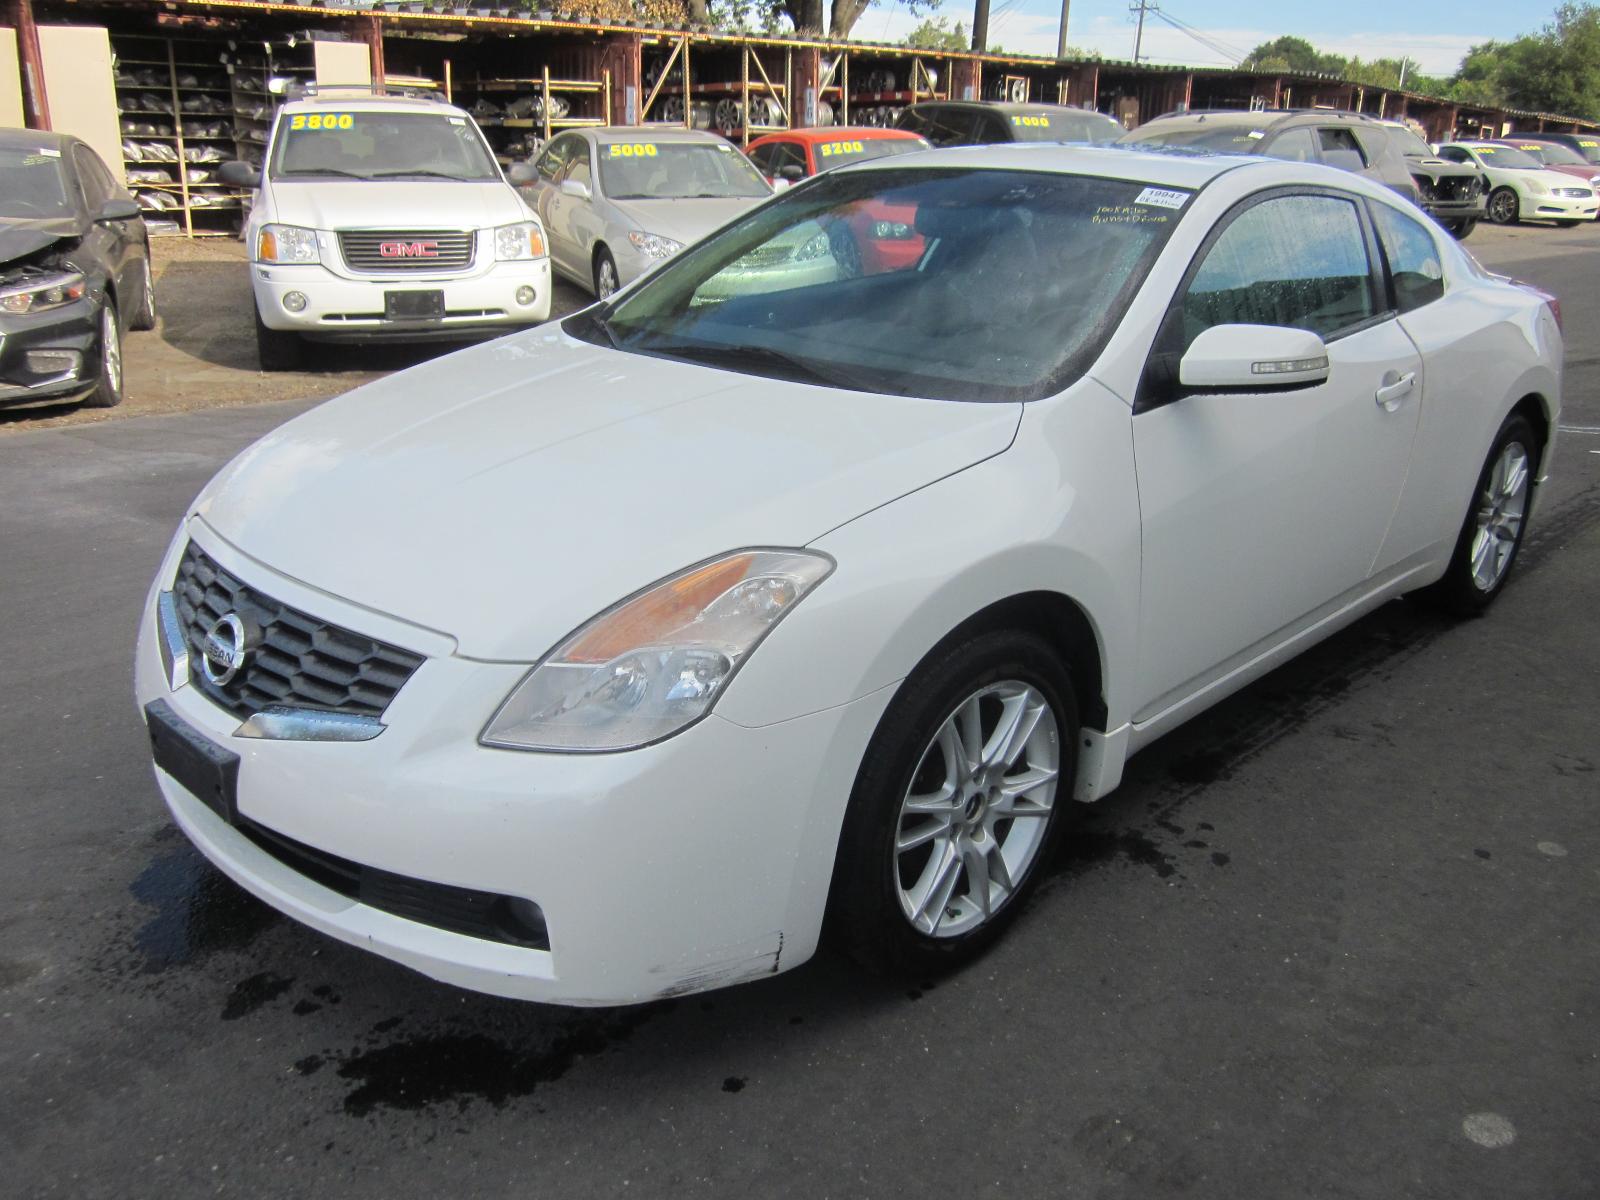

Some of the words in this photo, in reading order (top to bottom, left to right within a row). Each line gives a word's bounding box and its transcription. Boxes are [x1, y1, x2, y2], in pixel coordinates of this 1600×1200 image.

[291, 115, 353, 130] 3800
[610, 144, 657, 156] 5000
[1150, 190, 1183, 199] 19947
[379, 242, 439, 257] GMC
